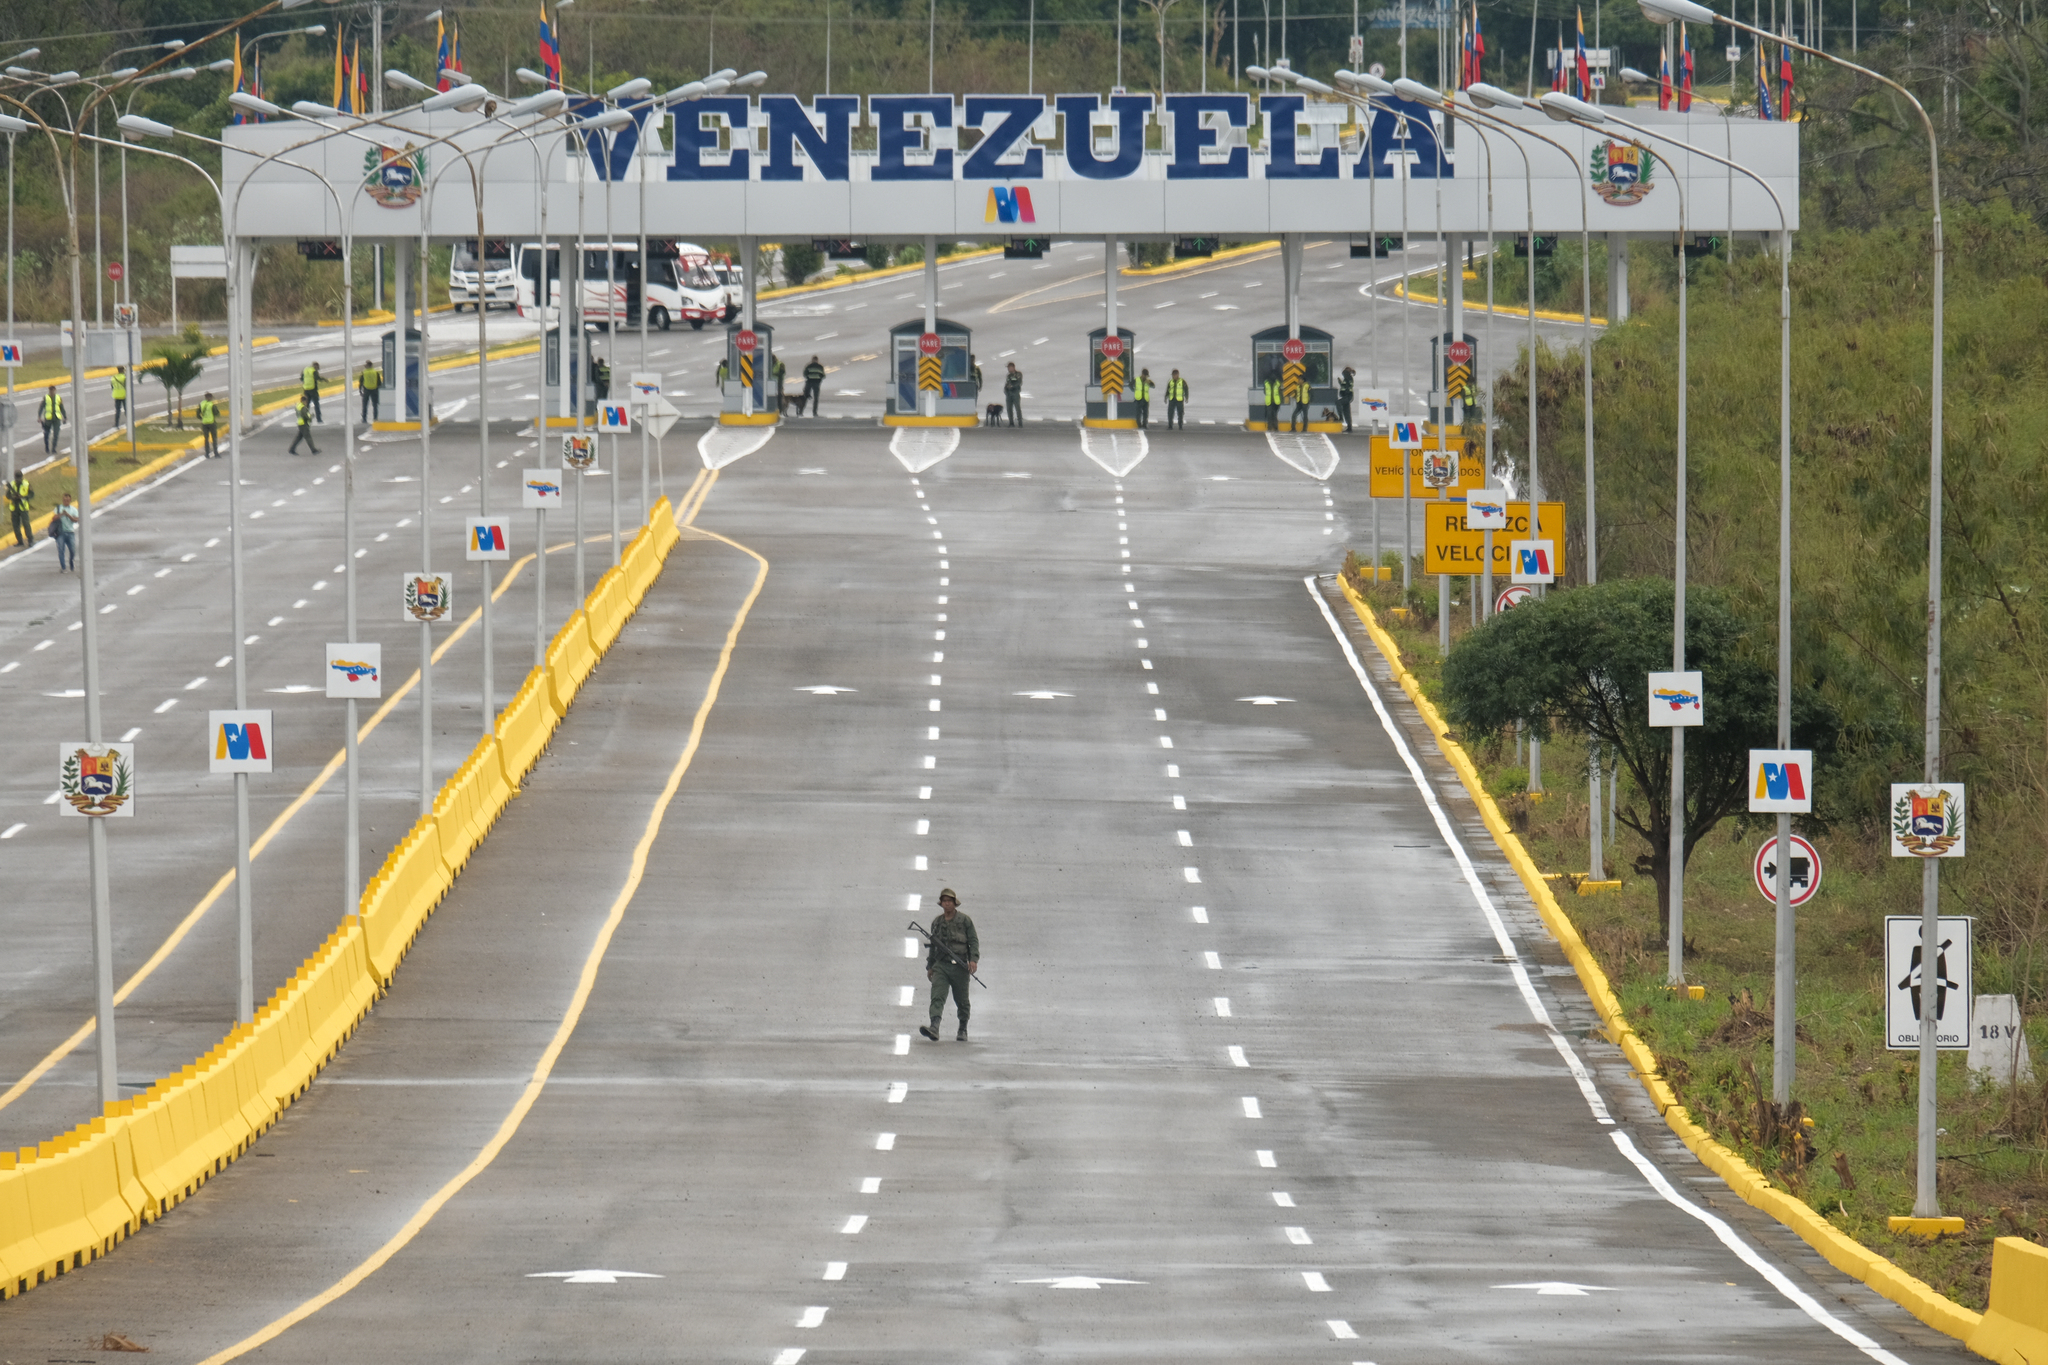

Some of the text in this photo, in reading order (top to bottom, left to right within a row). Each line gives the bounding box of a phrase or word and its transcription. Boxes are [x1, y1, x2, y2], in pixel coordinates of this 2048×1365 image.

[566, 94, 1455, 181] VENEZUELA
[737, 336, 756, 346] PARE
[921, 340, 939, 349] PARE
[1103, 342, 1121, 351] PARE
[1285, 346, 1303, 355] PARE
[1450, 348, 1468, 357] PARE
[1445, 515, 1543, 533] REZC
[1436, 544, 1510, 562] VELOCI
[1979, 1024, 2017, 1039] 18 V
[1898, 1034, 1960, 1043] OBLIORIO
